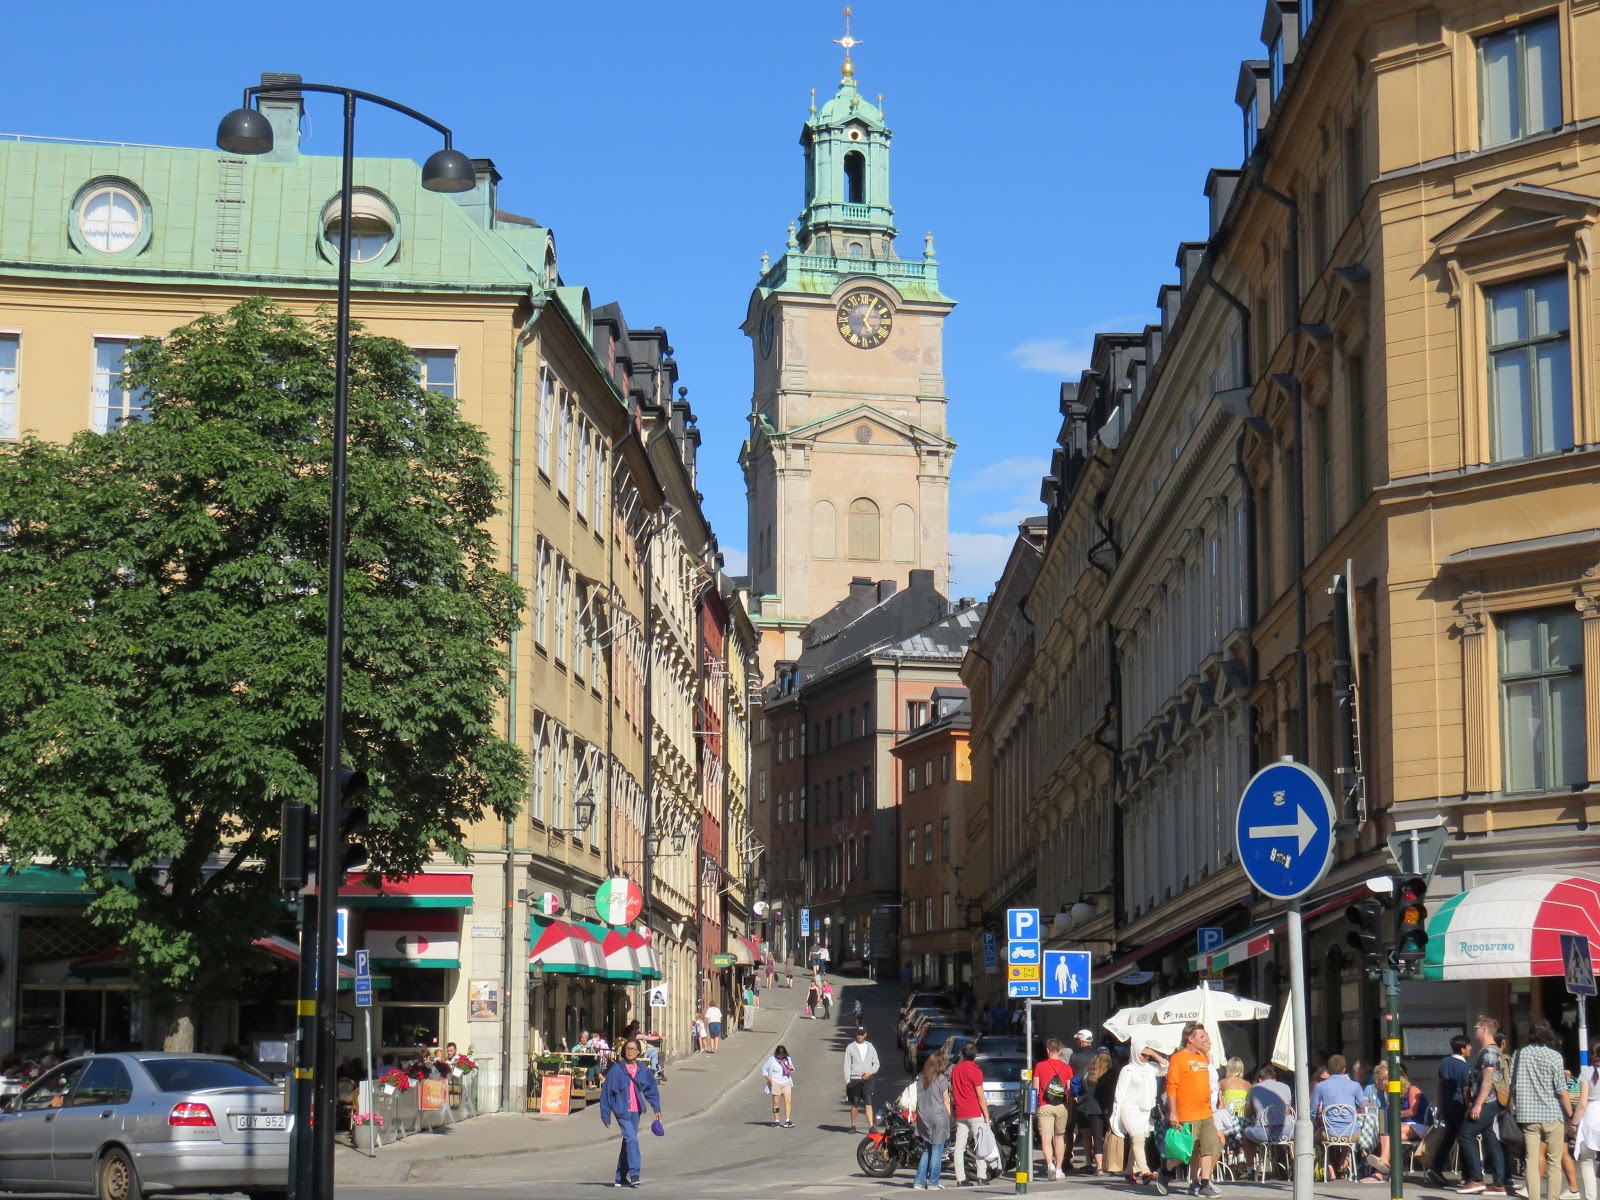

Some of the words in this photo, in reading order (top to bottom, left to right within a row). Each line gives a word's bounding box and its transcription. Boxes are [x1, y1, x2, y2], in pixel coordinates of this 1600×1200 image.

[1016, 912, 1034, 938] P
[1204, 930, 1218, 951] P
[1459, 941, 1515, 958] RODOLFINO
[359, 953, 367, 975] P
[239, 1117, 258, 1127] GUY
[265, 1117, 284, 1127] 952
